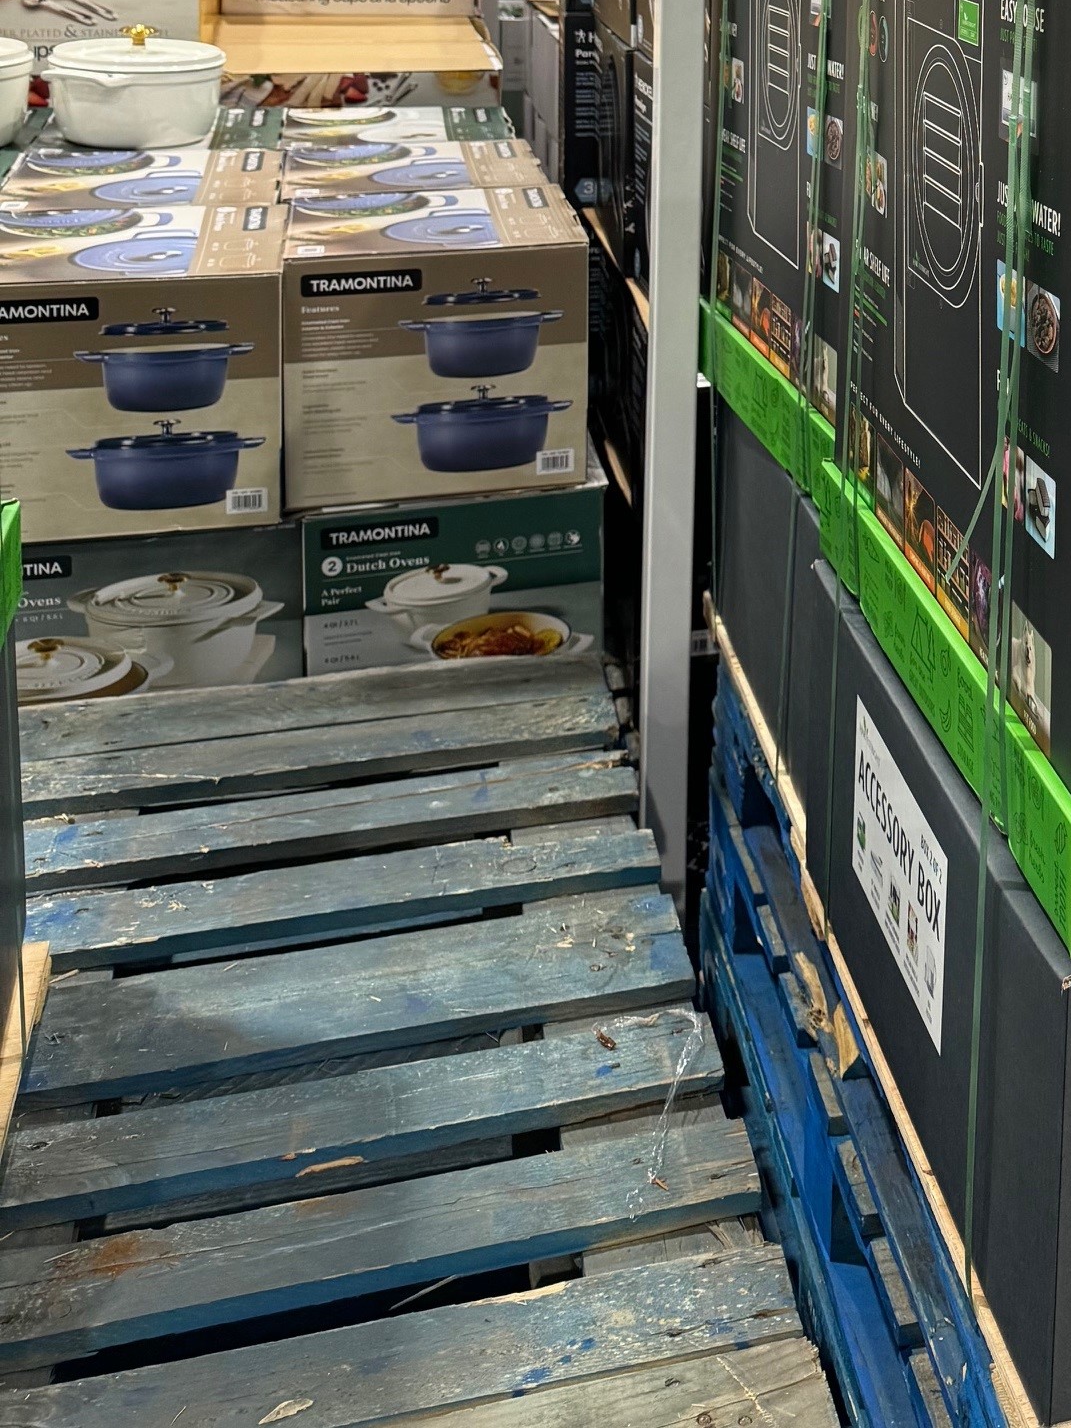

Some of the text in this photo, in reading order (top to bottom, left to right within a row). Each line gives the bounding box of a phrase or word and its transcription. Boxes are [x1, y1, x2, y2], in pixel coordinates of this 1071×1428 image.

[20, 23, 78, 39] PLATED &
[997, 180, 1061, 237] JUS WATER!
[310, 275, 413, 293] TRAMONTINA
[301, 304, 340, 315] Features
[329, 523, 430, 546] TRAMONTINA
[328, 560, 337, 574] 2
[346, 560, 386, 574] Dutch
[389, 555, 430, 570] Ovens
[321, 585, 362, 598] A Perfect
[321, 597, 340, 607] Pair
[858, 749, 914, 886] ACCESSORY
[917, 860, 941, 943] BOX
